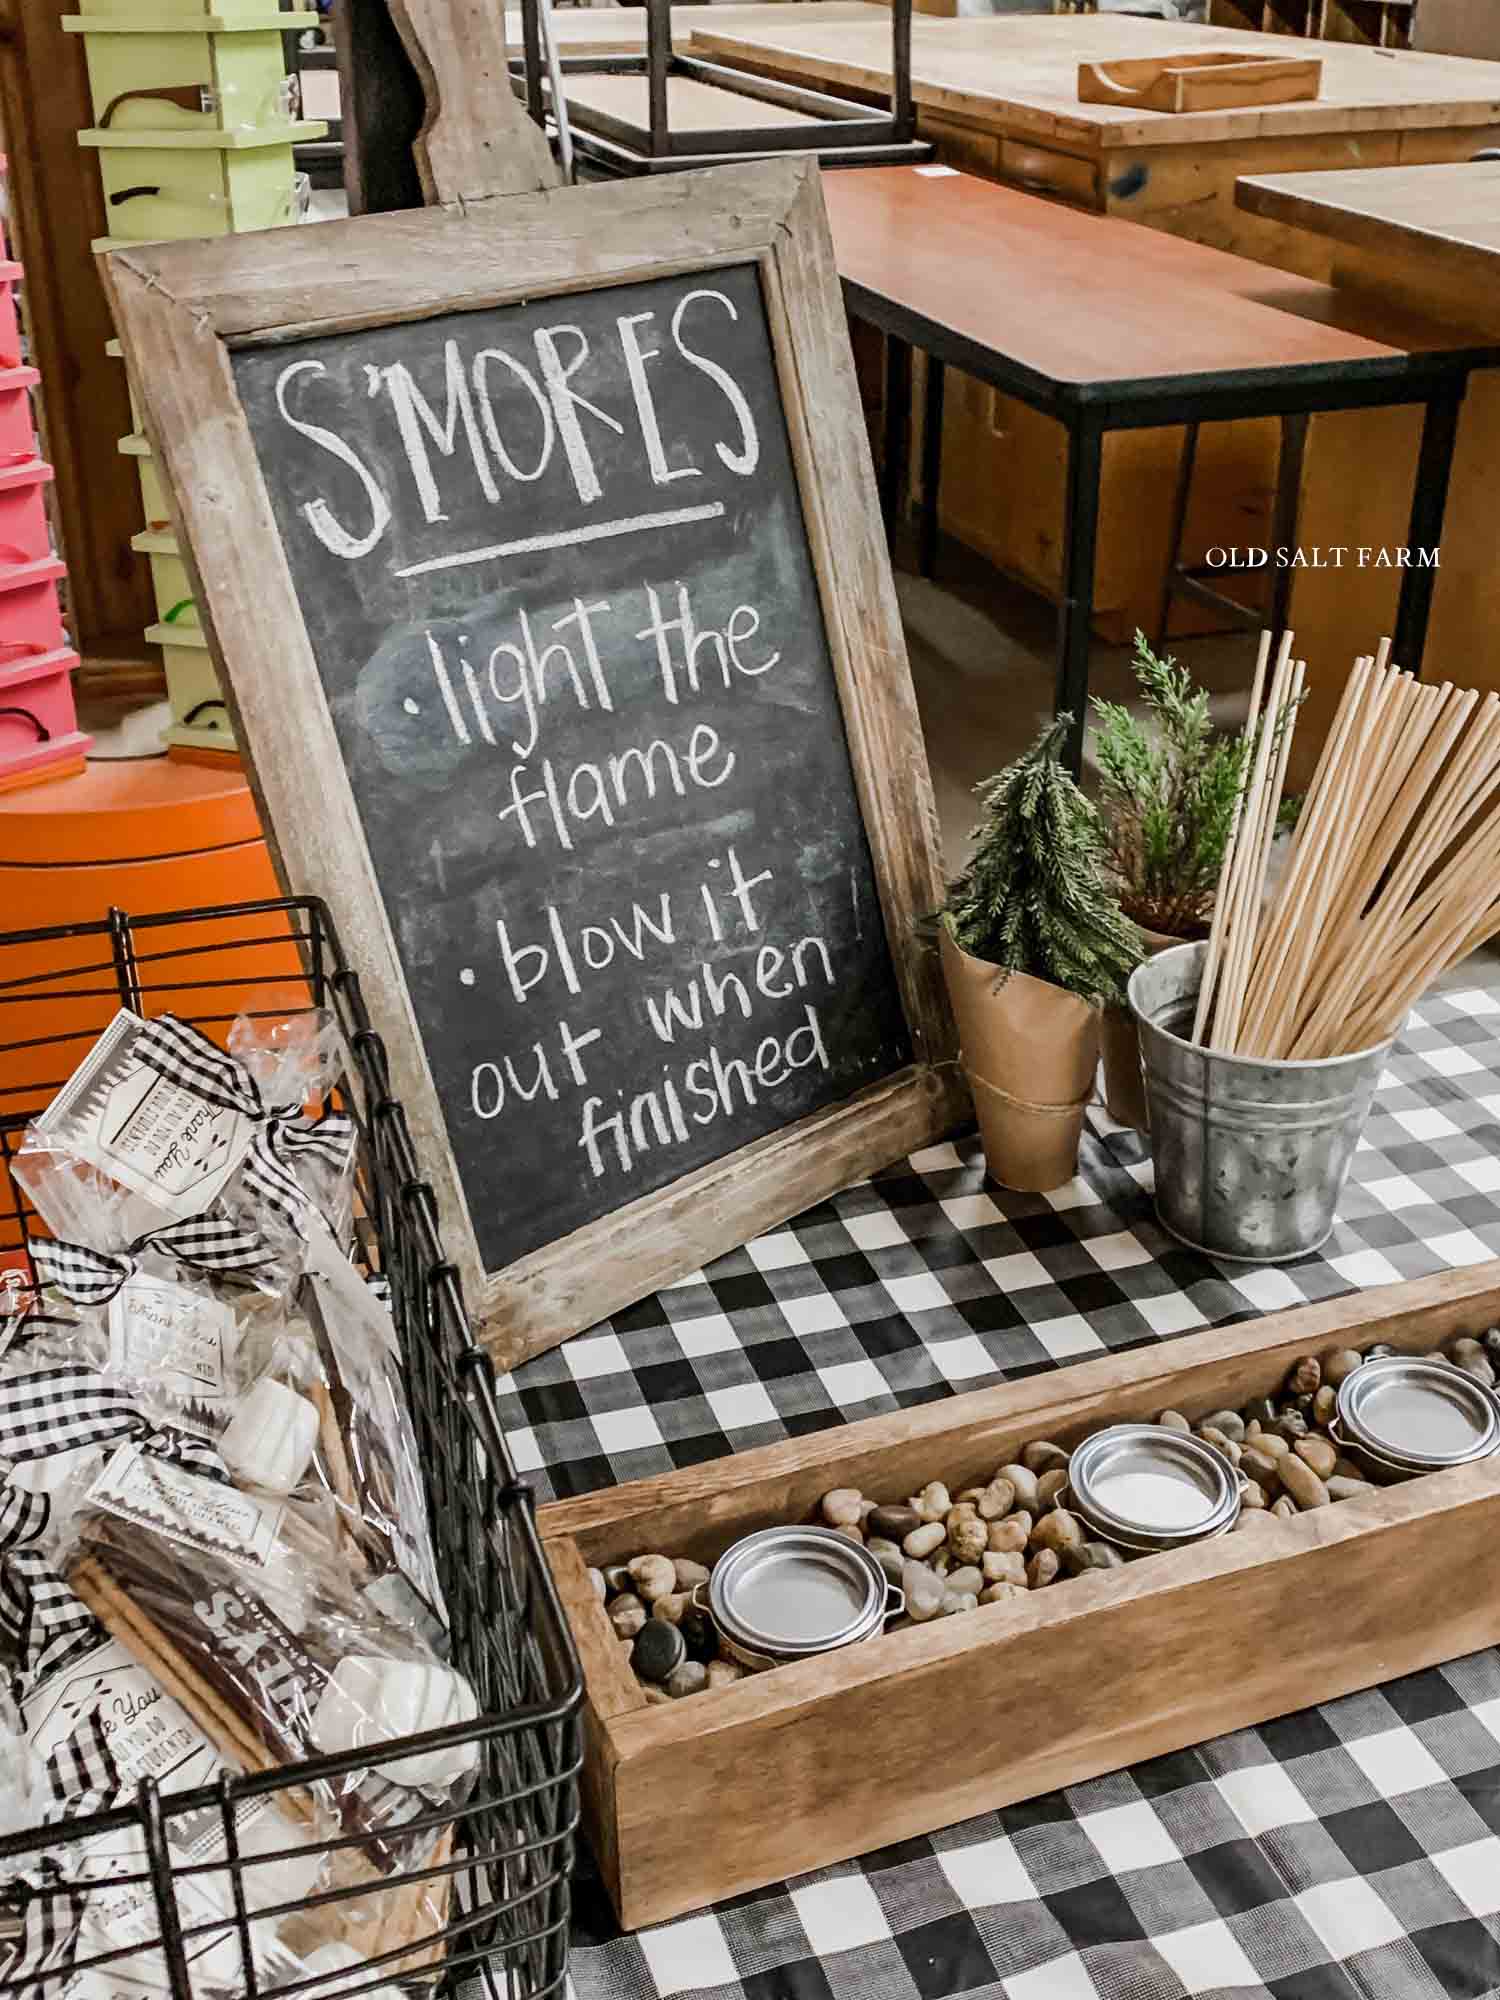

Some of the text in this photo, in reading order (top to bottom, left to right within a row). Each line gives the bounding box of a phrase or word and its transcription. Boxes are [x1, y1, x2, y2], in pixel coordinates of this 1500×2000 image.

[275, 289, 760, 560] S'MORES
[426, 579, 780, 758] light the
[498, 724, 736, 849] flame
[496, 846, 775, 1003] blow it
[471, 936, 837, 1120] out when
[577, 1004, 830, 1178] finished
[153, 1141, 191, 1178] You
[180, 1103, 225, 1144] Thank
[113, 1687, 162, 1726] You
